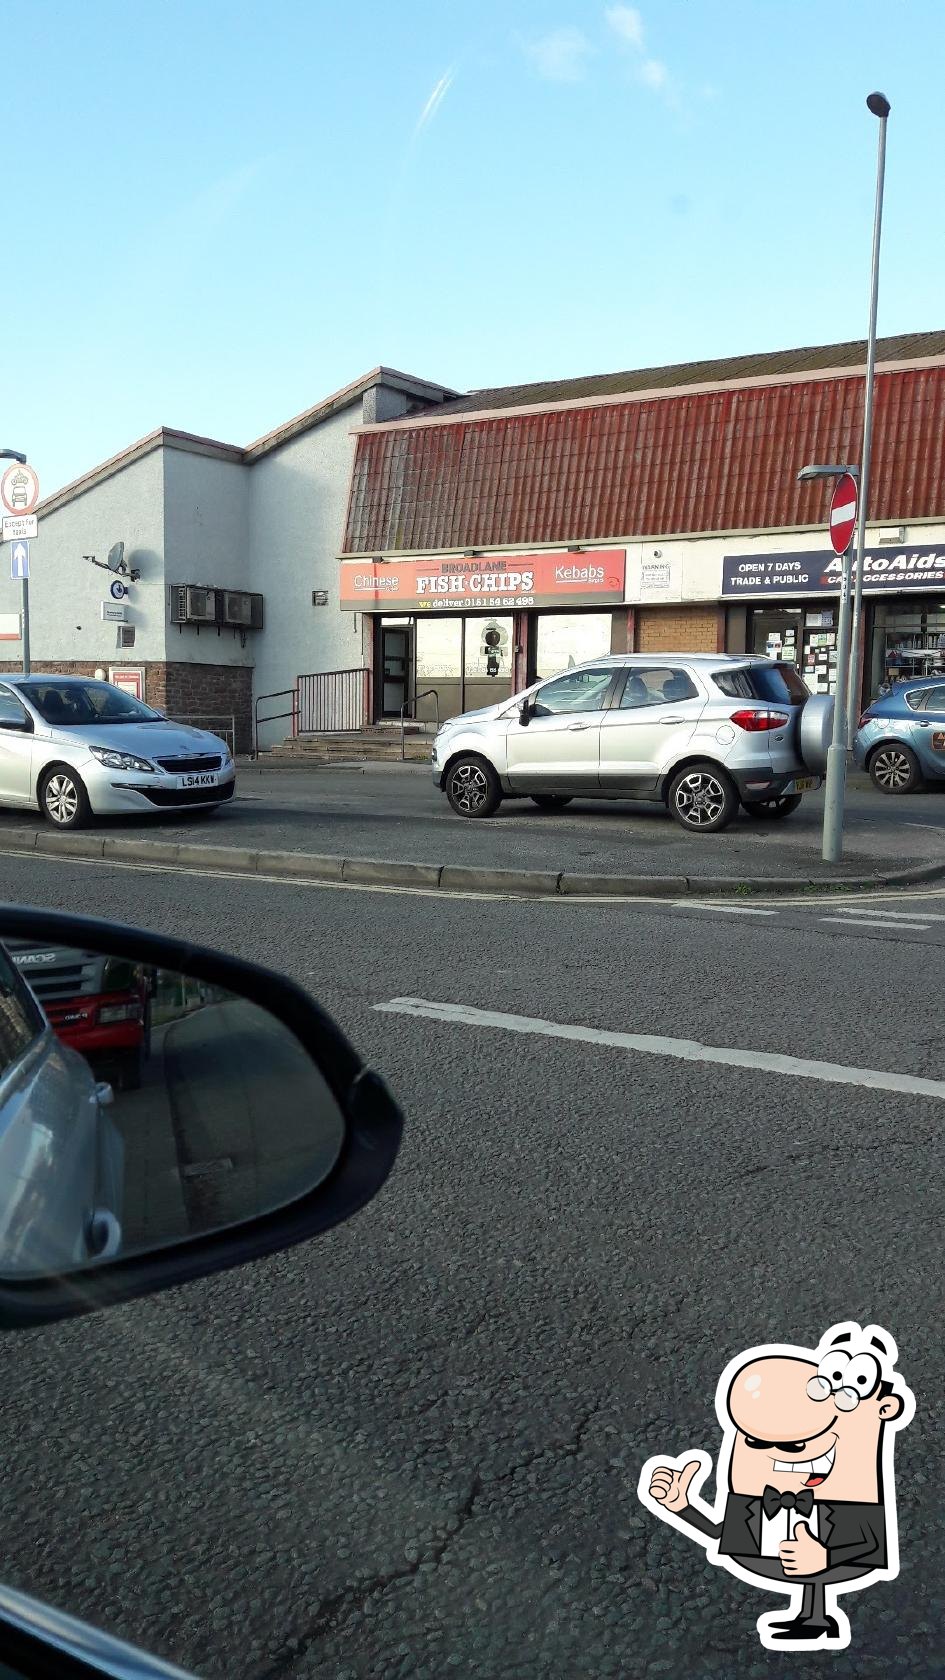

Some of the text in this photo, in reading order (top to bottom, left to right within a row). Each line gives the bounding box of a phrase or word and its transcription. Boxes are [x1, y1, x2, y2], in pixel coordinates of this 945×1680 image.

[739, 561, 801, 572] OPEN 7 DAYS
[824, 553, 945, 573] AtoAids
[555, 564, 604, 579] Kebabs
[354, 575, 399, 587] Chinese
[416, 571, 534, 594] FISH CHIPS
[731, 577, 761, 586] TRADE
[773, 574, 809, 584] PUBLIC
[419, 600, 430, 608] we
[432, 598, 463, 607] deliver
